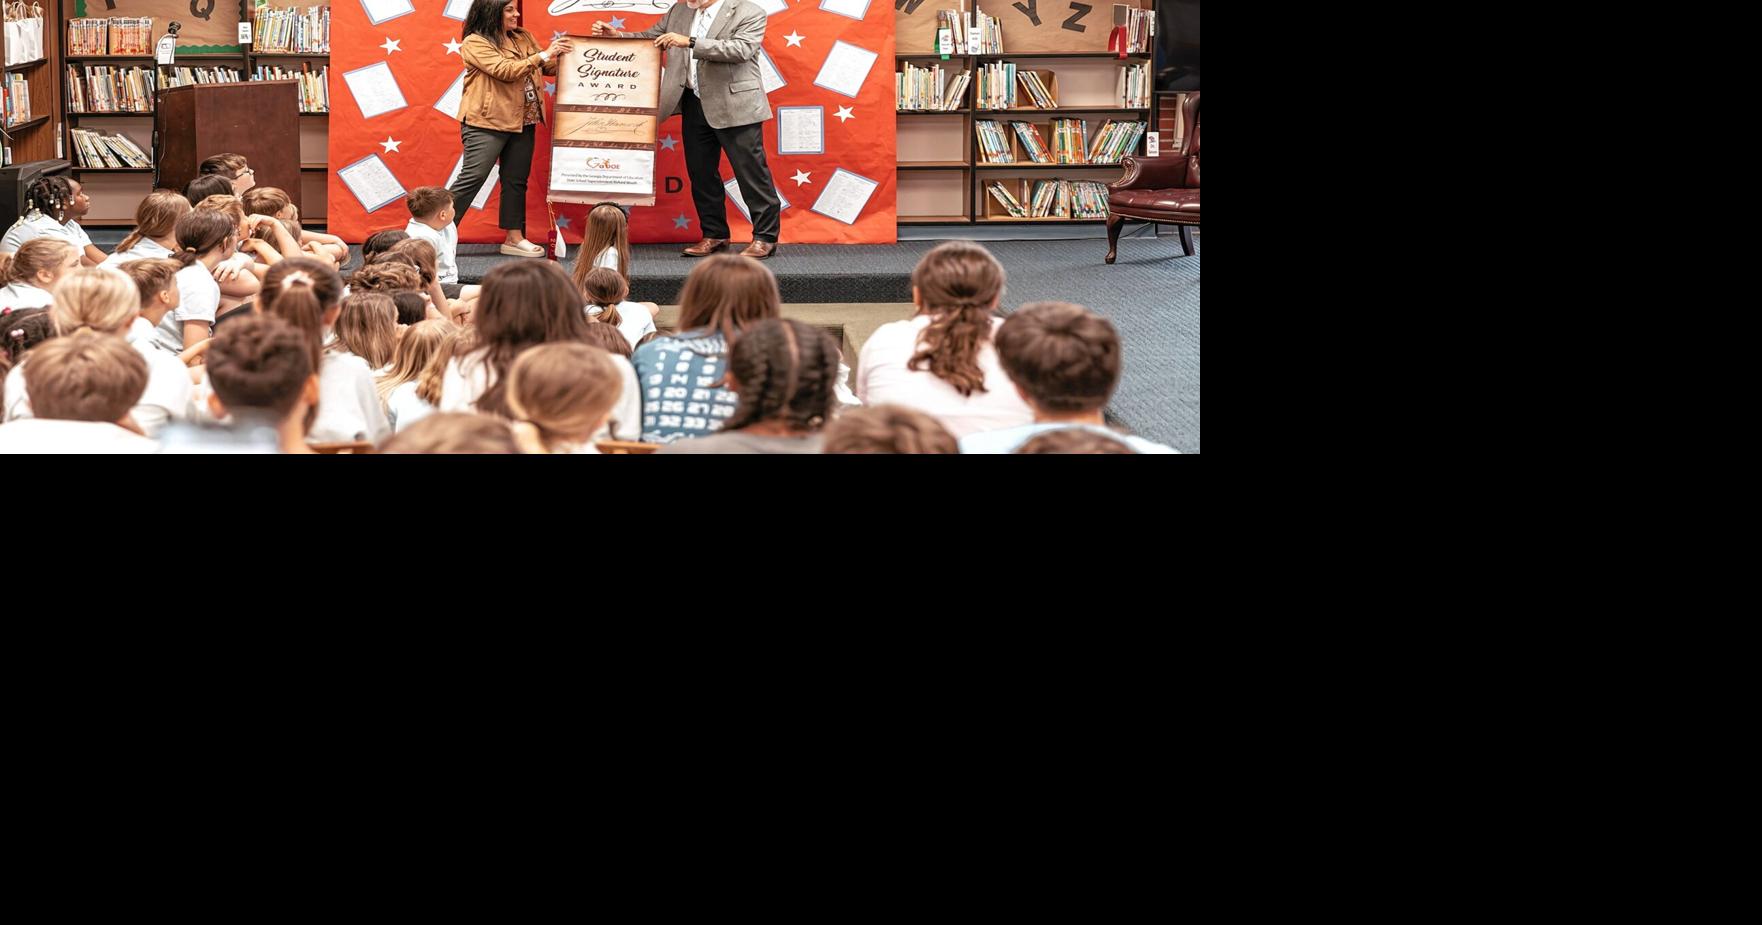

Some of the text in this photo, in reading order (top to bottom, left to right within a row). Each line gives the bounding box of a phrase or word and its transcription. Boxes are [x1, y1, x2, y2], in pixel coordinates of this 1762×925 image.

[190, 0, 215, 21] Q
[1012, 0, 1042, 26] Y
[1062, 1, 1092, 32] Z
[583, 48, 636, 63] Student
[577, 64, 640, 80] Signature
[578, 82, 637, 90] AWARD
[665, 176, 684, 193] D
